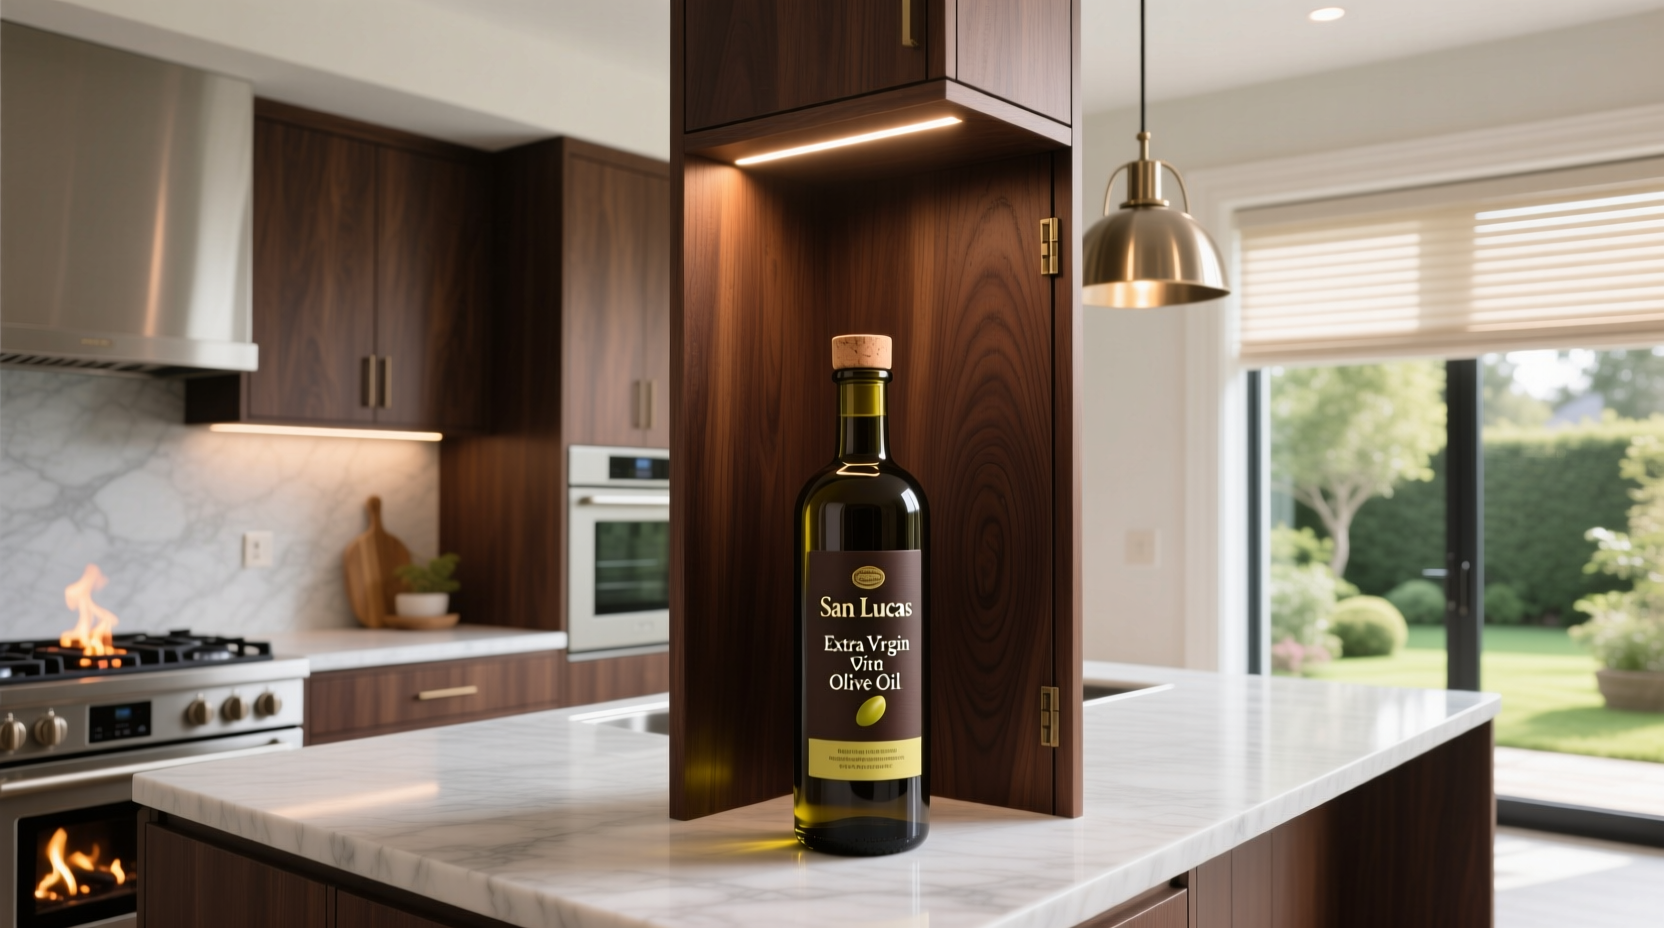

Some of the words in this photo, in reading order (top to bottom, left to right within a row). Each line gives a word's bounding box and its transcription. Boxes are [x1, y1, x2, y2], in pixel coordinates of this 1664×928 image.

[820, 596, 854, 617] San
[860, 597, 912, 617] Lucas
[824, 635, 864, 652] Extra
[829, 673, 872, 691] Olive
[876, 672, 902, 690] Oil
